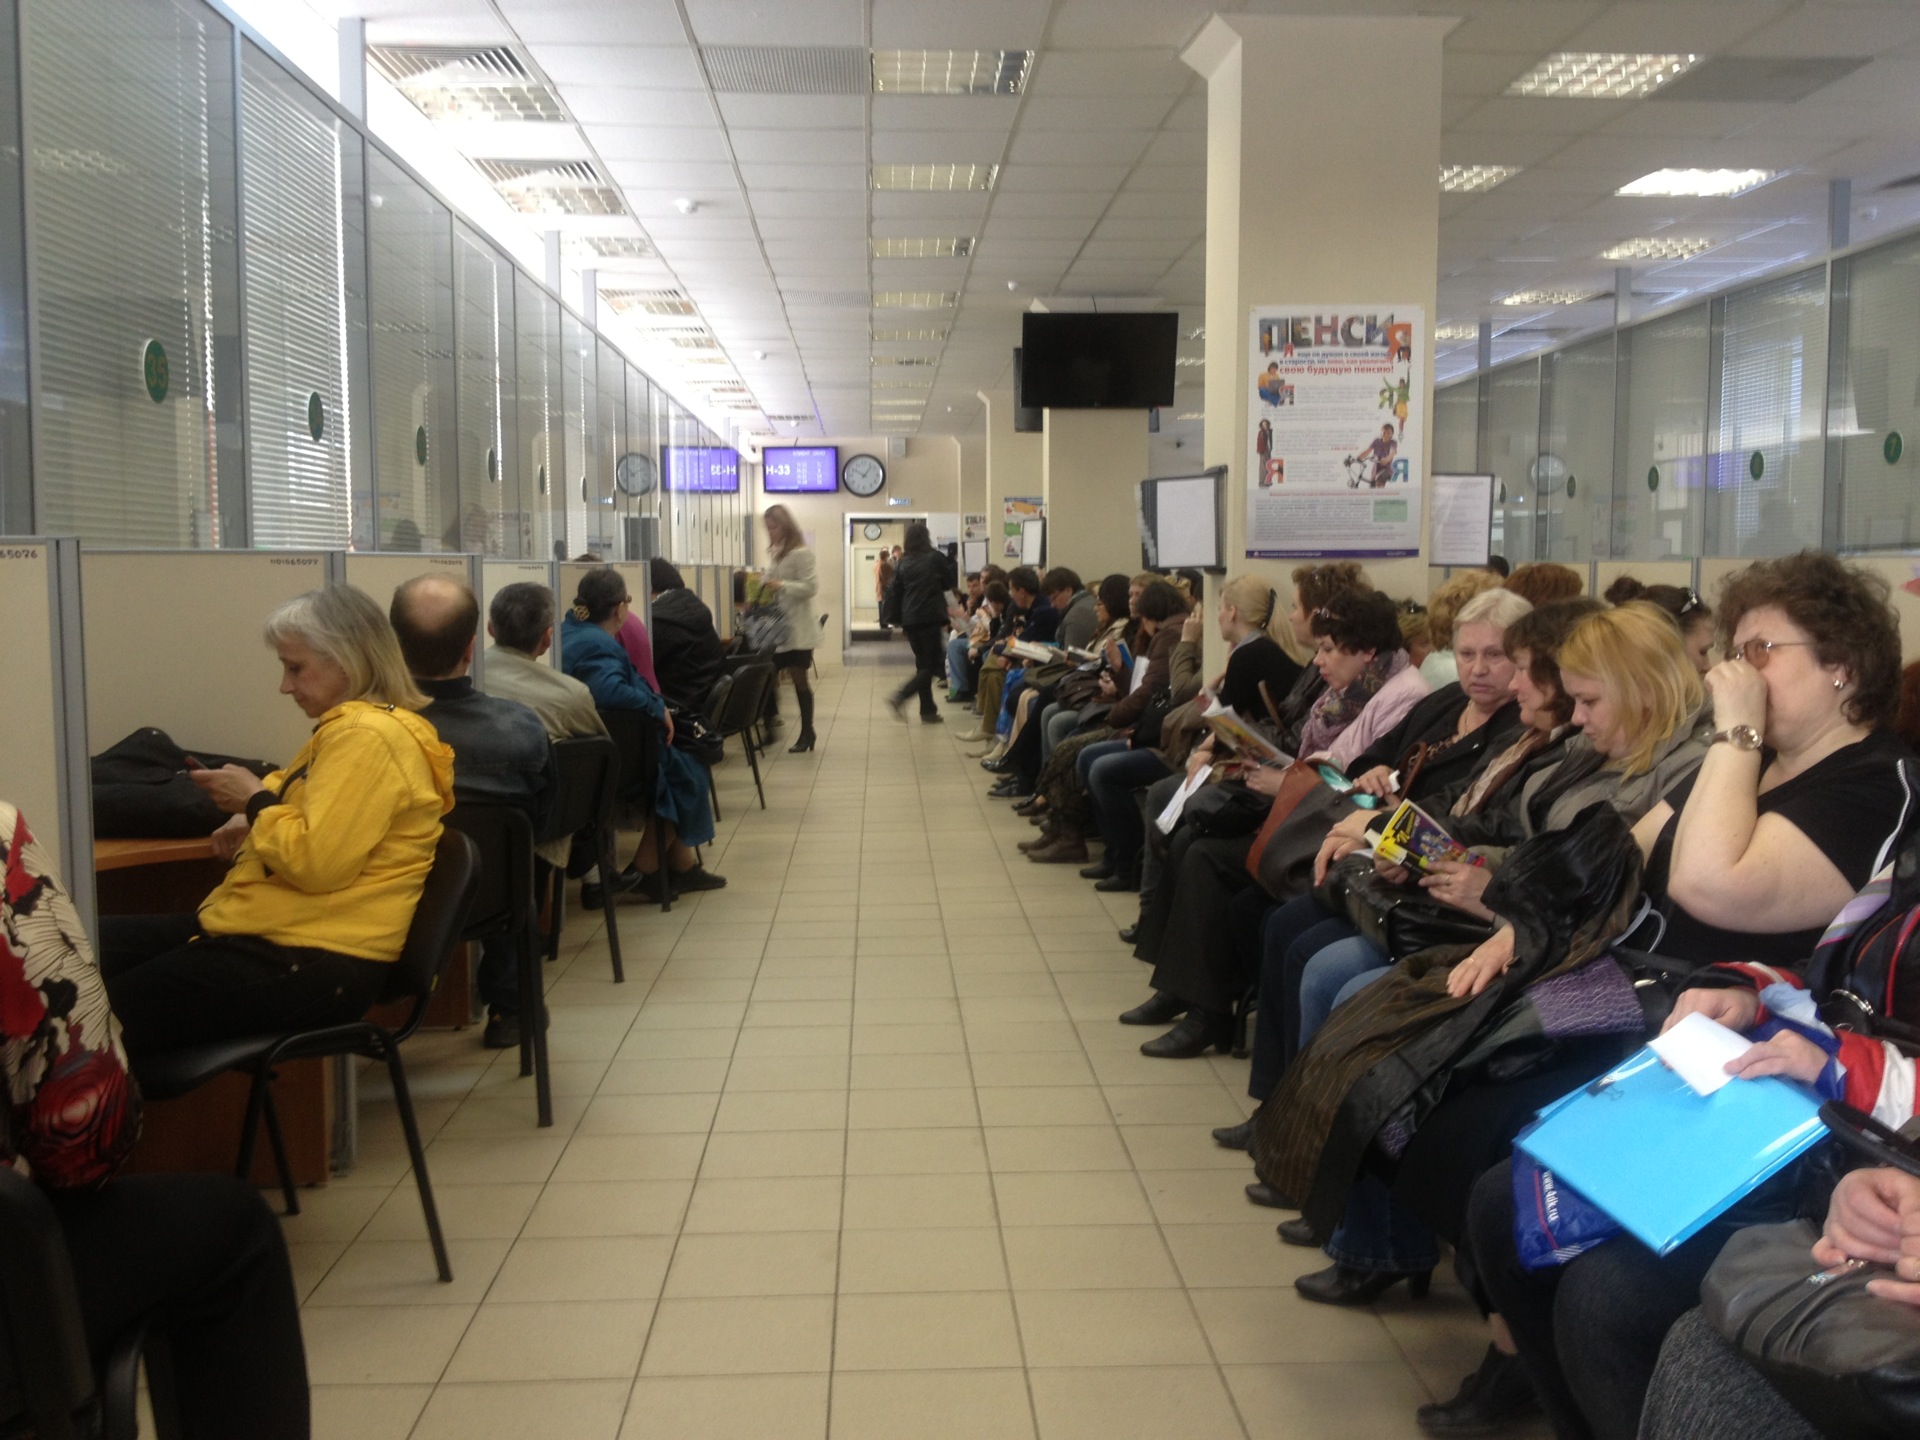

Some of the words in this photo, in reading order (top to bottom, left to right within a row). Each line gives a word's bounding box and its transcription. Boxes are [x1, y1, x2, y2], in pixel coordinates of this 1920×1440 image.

[1259, 312, 1412, 358] ПЕНСИЯ
[1283, 343, 1294, 358] Я
[148, 353, 167, 389] 35
[1279, 366, 1305, 374] свою
[1307, 365, 1352, 375] будущую
[1354, 365, 1394, 373] пенсию!
[1264, 458, 1284, 484] Я
[1391, 458, 1409, 482] Я
[1541, 1170, 1560, 1224] www.4dk.ru
